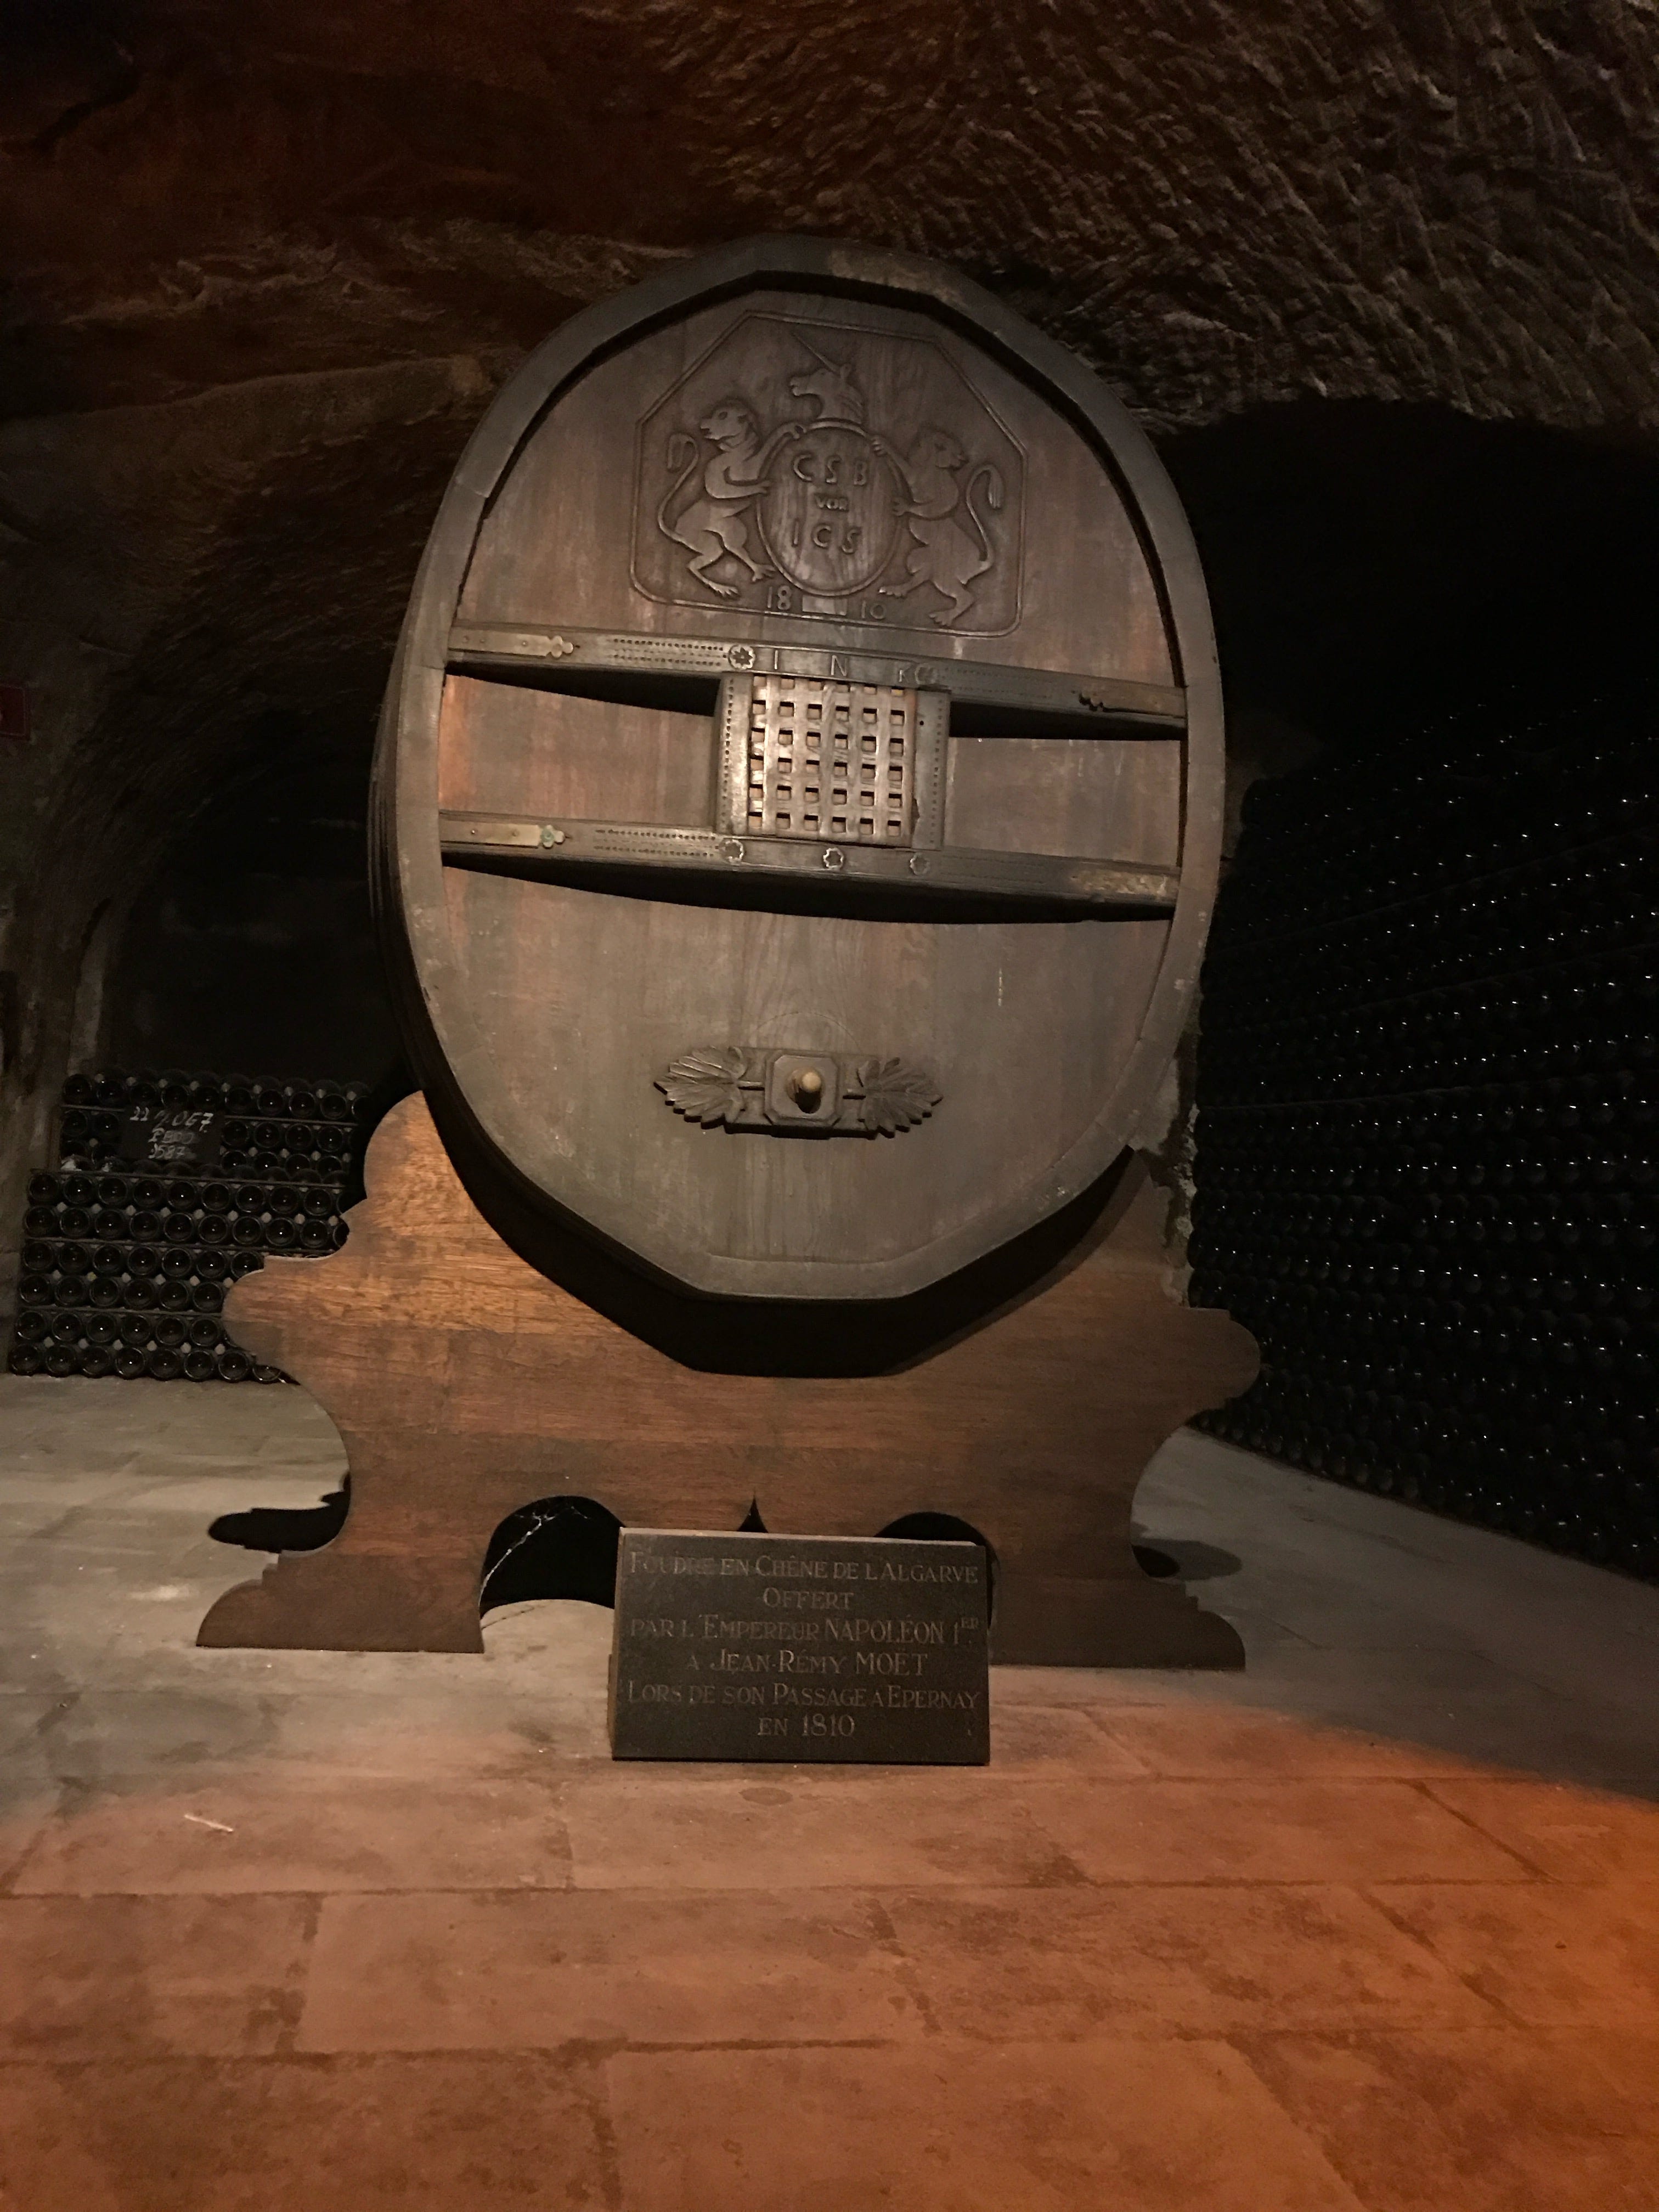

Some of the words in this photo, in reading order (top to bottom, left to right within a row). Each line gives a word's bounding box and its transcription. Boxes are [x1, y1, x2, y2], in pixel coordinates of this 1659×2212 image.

[720, 1558, 749, 1576] EN
[833, 1562, 860, 1580] DE
[763, 1587, 855, 1611] OFFERT
[631, 1619, 674, 1637] PAR
[825, 1614, 944, 1645] NAPOLÉON
[628, 1680, 682, 1702] LORS
[689, 1685, 715, 1703] DE
[722, 1686, 766, 1705] SON
[774, 1682, 867, 1708] PASSAGE
[757, 1716, 789, 1736] EN
[802, 1712, 855, 1737] 1810
